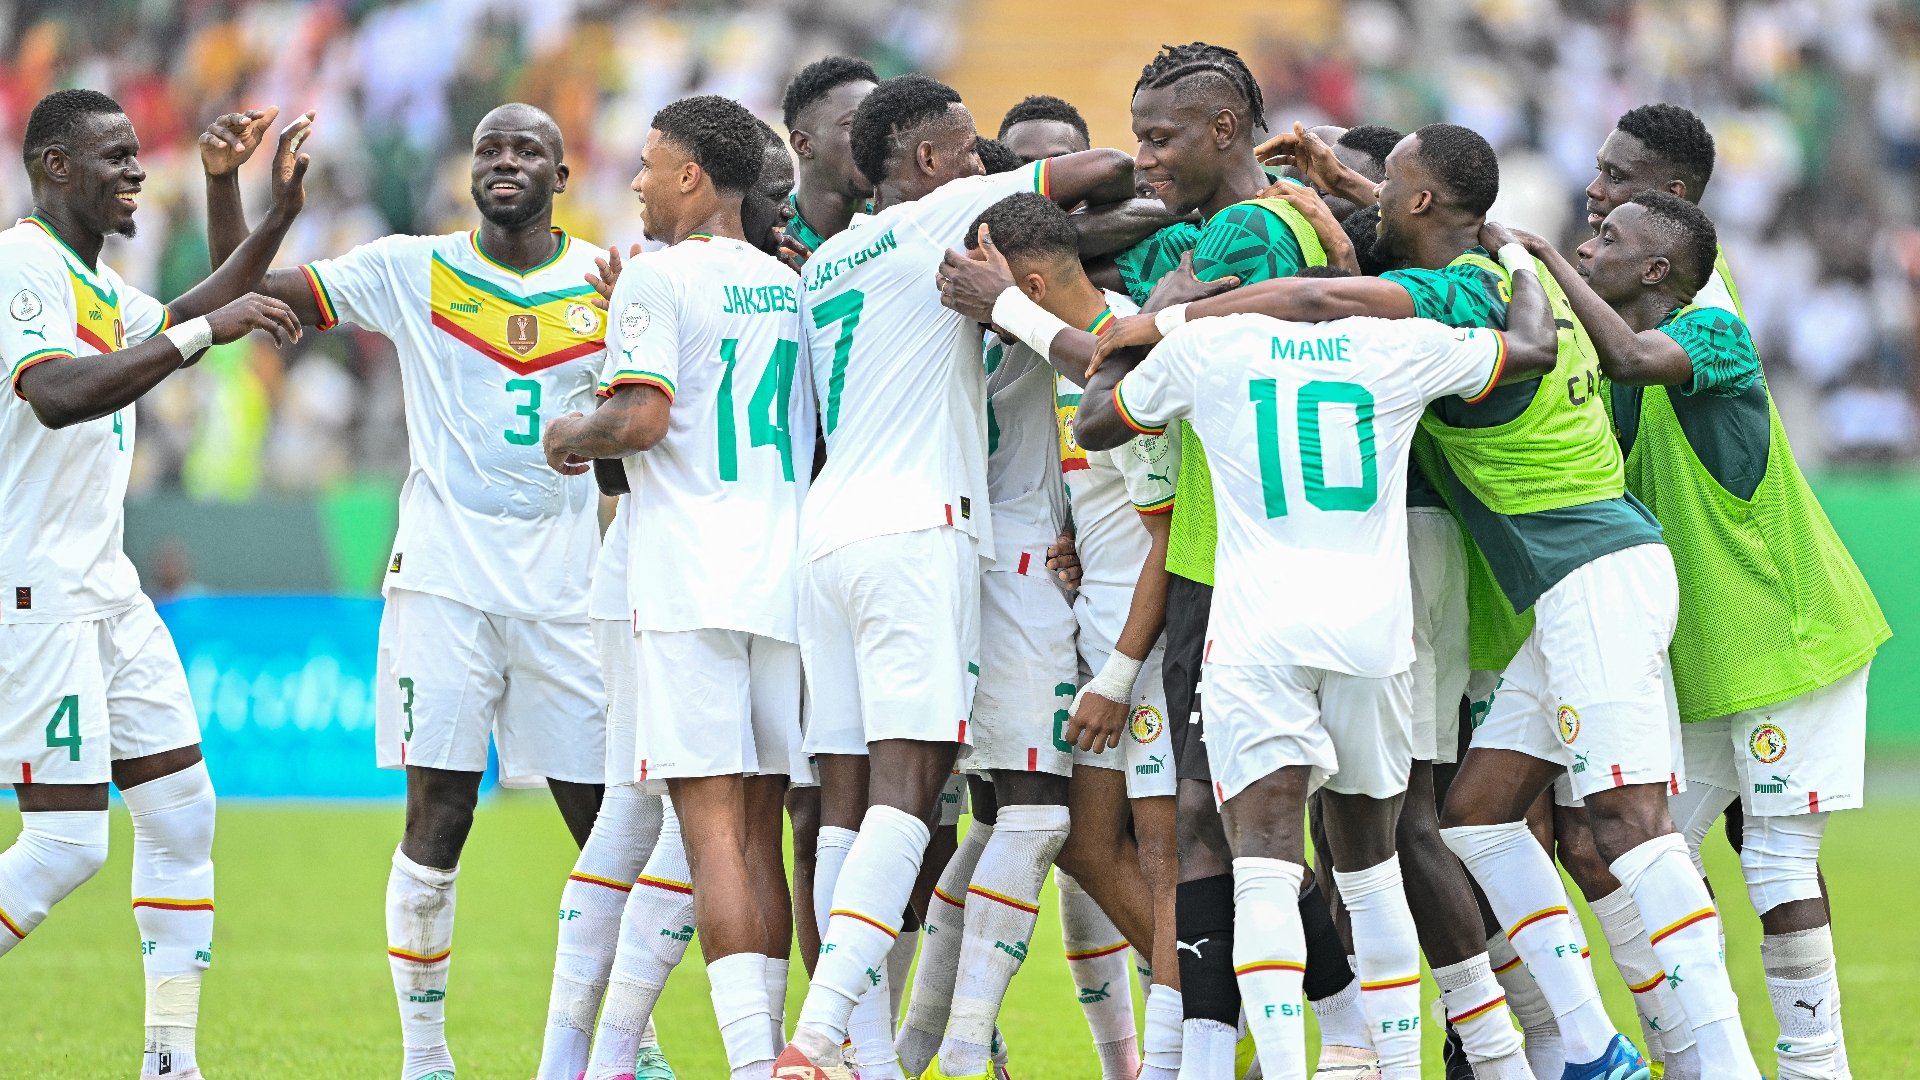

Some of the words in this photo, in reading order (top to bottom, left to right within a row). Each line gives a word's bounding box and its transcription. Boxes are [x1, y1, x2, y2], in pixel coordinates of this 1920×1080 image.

[450, 302, 479, 313] PUMA
[723, 285, 799, 314] JAKOBS
[811, 288, 865, 437] 7
[1271, 334, 1352, 362] MANÉ
[503, 379, 542, 446] 3
[716, 338, 799, 482] 14
[1249, 377, 1379, 520] 10
[45, 695, 82, 762] 4
[399, 676, 415, 743] 3
[1135, 763, 1160, 776] PUMA
[1754, 783, 1783, 794] PUMA
